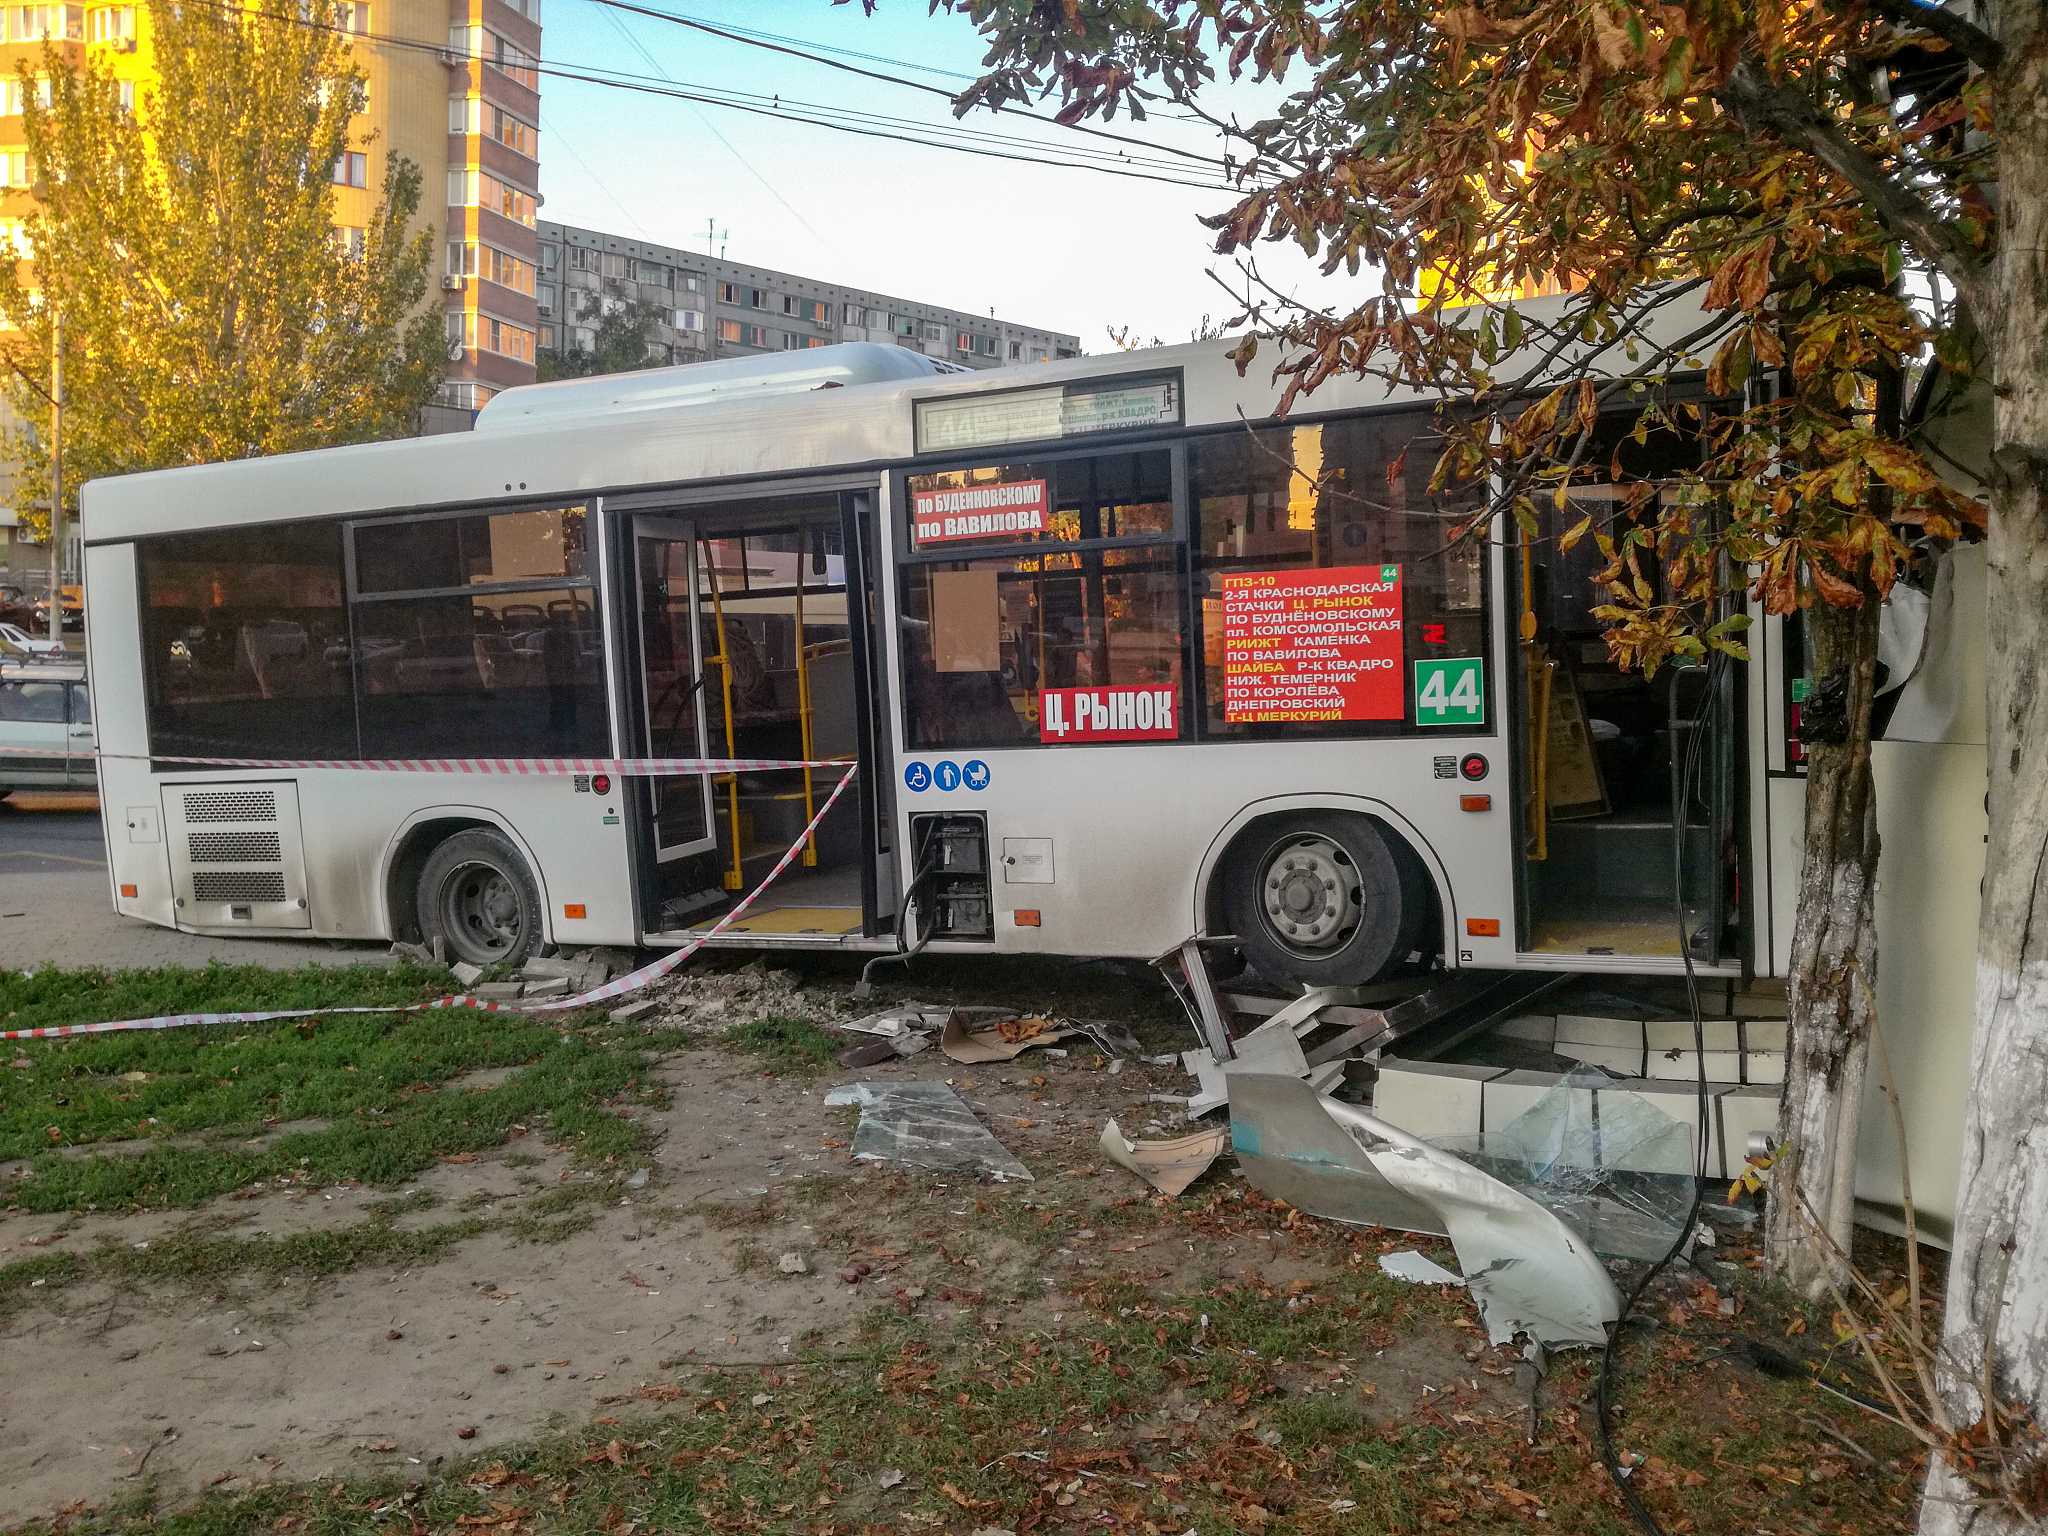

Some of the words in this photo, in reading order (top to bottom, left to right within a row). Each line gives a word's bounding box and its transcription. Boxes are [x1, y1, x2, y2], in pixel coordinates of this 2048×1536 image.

[1118, 404, 1157, 420] КВАДРО
[934, 484, 1042, 513] БУДЕННОВСКОМУ
[944, 510, 1042, 537] ВАВИЛОВА
[1383, 568, 1398, 577] 44
[1225, 576, 1275, 589] ГПЗ-10
[1225, 589, 1249, 600] 2-Я
[1253, 582, 1394, 600] КРАСНОДАРСКАЯ
[1225, 600, 1285, 612] СТАЧКИ
[1293, 599, 1309, 611] Ц.
[1313, 595, 1374, 608] РЫНОК
[1226, 613, 1249, 625] ПО
[1252, 607, 1396, 626] БУДНЁНОВСКОМУ
[1252, 620, 1401, 637] КОМСОМОЛЬСКАЯ
[1226, 637, 1282, 650] РИИЖТ
[1294, 634, 1372, 647] КАМЕНКА
[1227, 650, 1249, 662] ПО
[1253, 648, 1342, 661] ВАВИЛОВА
[1227, 660, 1285, 674] ШАЙБА
[1297, 660, 1323, 672] Р-К
[1327, 658, 1395, 673] КВАДРО
[1227, 674, 1266, 686] НИЖ.
[1270, 671, 1357, 684] ТЕМЕРНИК
[1227, 687, 1250, 698] ПО
[1253, 683, 1340, 697] КОРОЛЁВА
[1419, 668, 1481, 716] 44
[1227, 696, 1346, 712] ДНЕПРОВСКИЙ
[1045, 693, 1070, 737] Ц.
[1074, 690, 1173, 731] РЫНОК
[1227, 711, 1254, 723] Т-Ц
[1257, 708, 1342, 722] МЕРКУРИЙ
